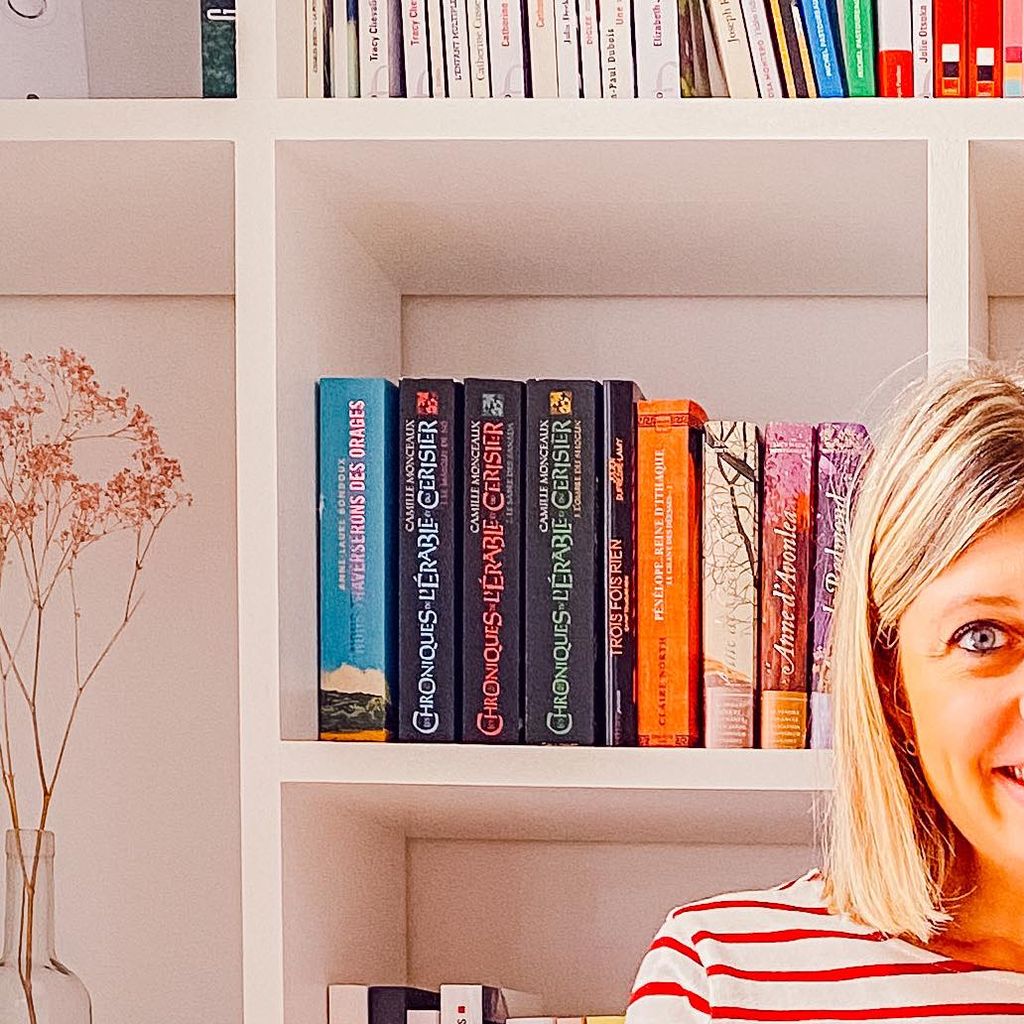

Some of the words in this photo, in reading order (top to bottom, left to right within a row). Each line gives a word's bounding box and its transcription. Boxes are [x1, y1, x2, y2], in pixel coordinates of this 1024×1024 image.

[411, 21, 419, 45] Tracy
[501, 3, 509, 47] Catherine
[653, 5, 662, 47] Elizabeth
[721, 8, 740, 43] Joseph
[370, 38, 379, 61] Tracy
[475, 32, 484, 80] Catherine
[349, 400, 365, 458] ORAGES
[406, 420, 414, 484] MONCEAUX
[471, 421, 480, 485] MONCEAUX
[540, 420, 548, 484] MONCEAUX
[349, 463, 365, 491] DES
[417, 420, 439, 509] CERISIER
[482, 422, 504, 511] CERISIER
[551, 420, 572, 509] CERISIER
[406, 487, 414, 532] CAMILLE
[470, 488, 480, 533] CAMILLE
[539, 487, 548, 532] CAMILLE
[413, 518, 439, 600] L'ÉRABLE
[478, 519, 505, 602] L'ÉRABLE
[548, 518, 573, 601] L'ÉRABLE
[609, 540, 622, 573] RIEN
[654, 521, 664, 555] REINE
[773, 512, 797, 606] d'Avonlea
[609, 577, 622, 610] FOIS
[609, 613, 623, 655] TROIS
[658, 637, 667, 678] NORTH
[773, 610, 795, 674] Anne
[412, 610, 439, 734] CHRONIQUES
[477, 612, 503, 735] CHRONIQUES
[546, 611, 572, 735] CHRONIQUES
[659, 683, 667, 726] CLAIRE
